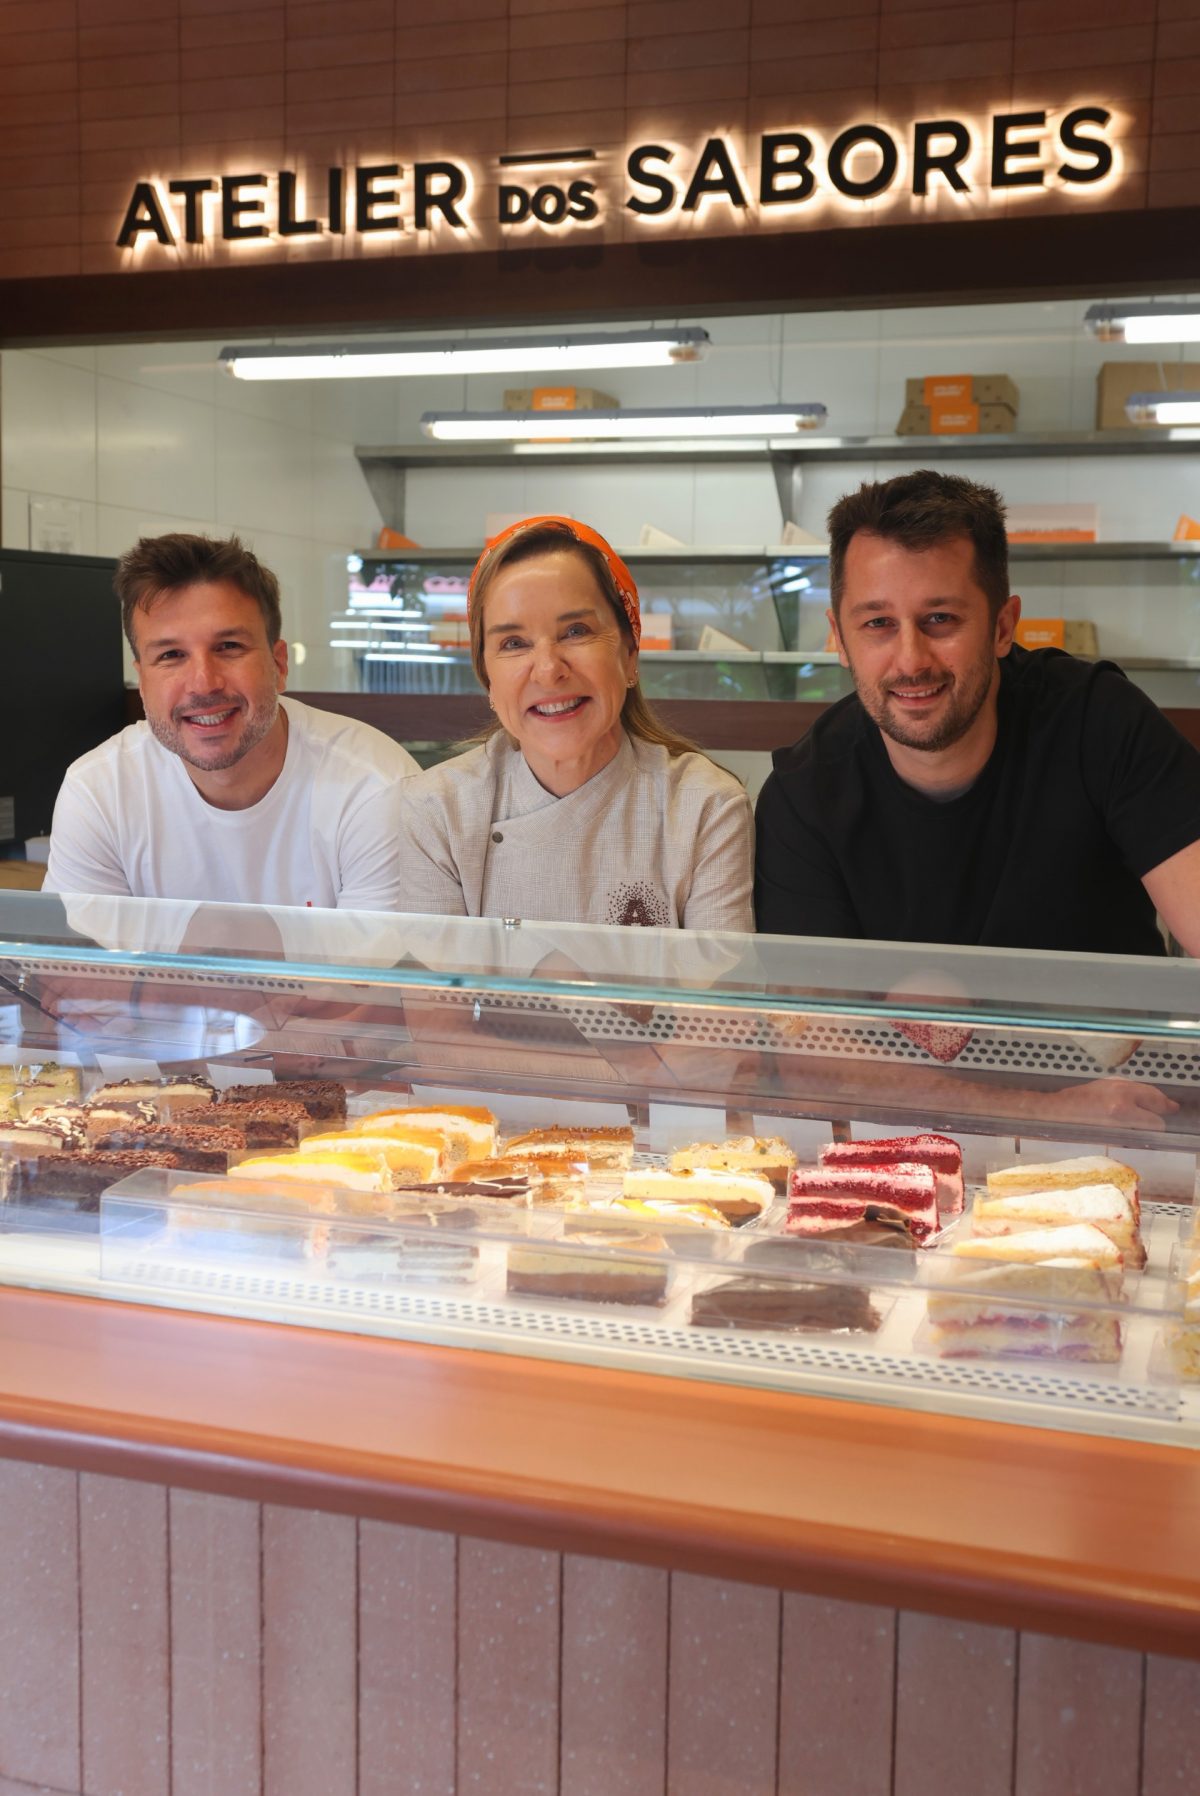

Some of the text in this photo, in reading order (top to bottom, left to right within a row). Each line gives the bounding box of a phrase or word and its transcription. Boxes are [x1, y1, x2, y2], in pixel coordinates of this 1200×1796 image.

[116, 106, 1112, 248] ATELIER DOS SABORES
